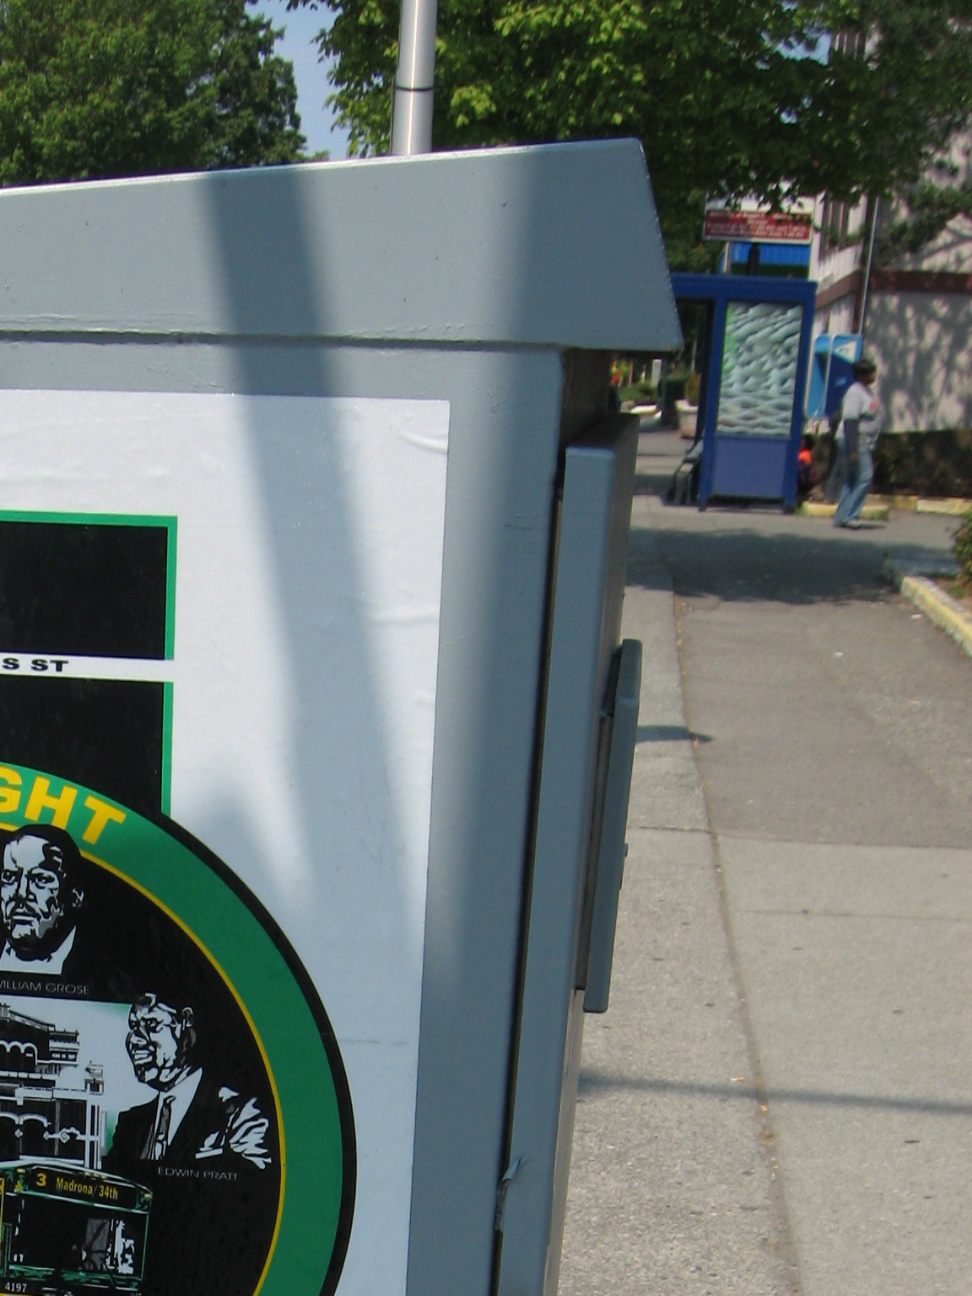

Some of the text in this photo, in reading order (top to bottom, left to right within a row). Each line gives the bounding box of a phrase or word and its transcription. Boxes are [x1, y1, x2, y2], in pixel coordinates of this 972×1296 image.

[31, 658, 69, 673] ST
[45, 982, 90, 996] GROSE
[157, 1166, 238, 1182] EDWIN PRATT
[36, 1172, 47, 1187] 3
[98, 1185, 119, 1200] 34th
[4, 1281, 28, 1293] 4197
